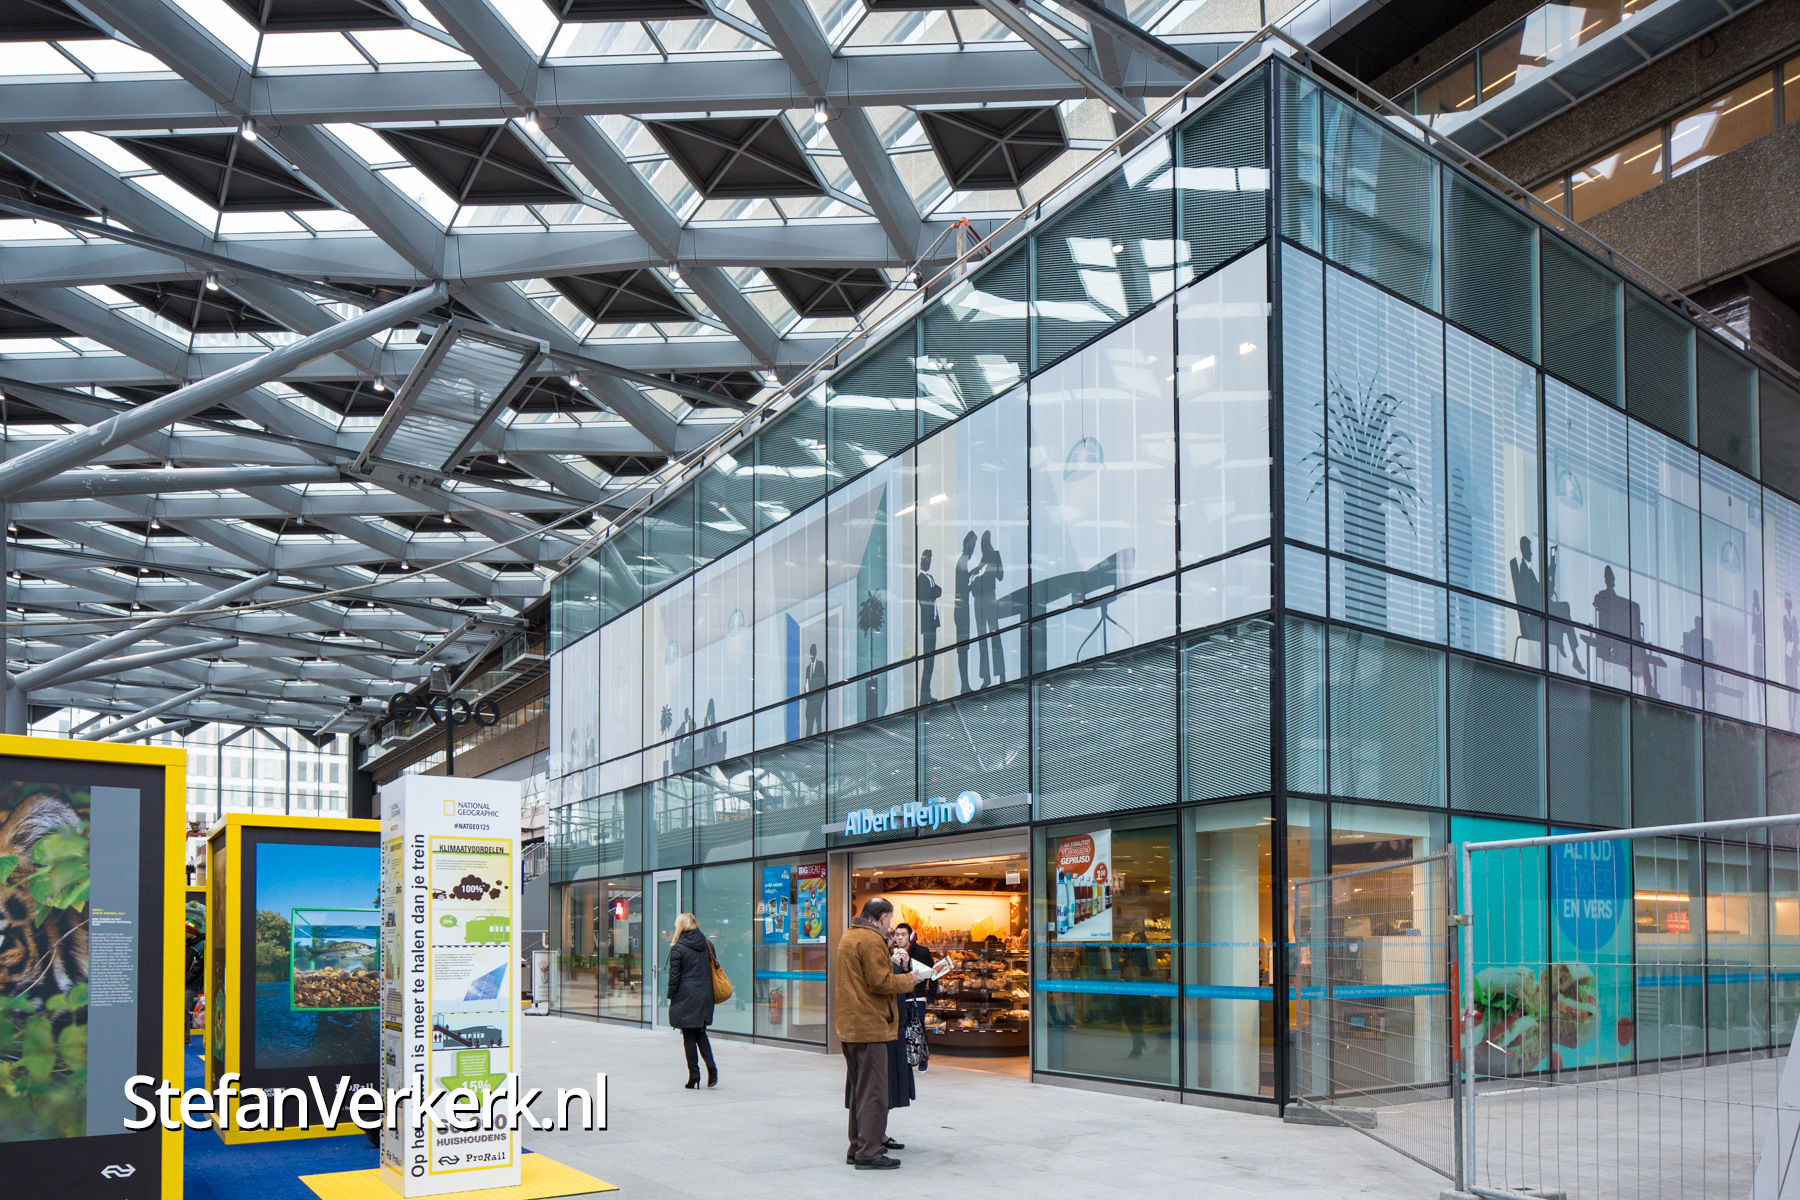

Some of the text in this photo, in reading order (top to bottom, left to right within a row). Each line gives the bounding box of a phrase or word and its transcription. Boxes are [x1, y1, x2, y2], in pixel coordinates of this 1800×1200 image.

[457, 802, 491, 810] NATIONAL
[457, 808, 500, 818] GEOGRAPHIC
[844, 796, 953, 837] Albert Heijn
[411, 834, 425, 870] trein
[439, 844, 505, 854] KLIMAATVOORDELEN
[1563, 840, 1612, 861] ALTIJD
[411, 875, 428, 890] je
[461, 885, 483, 893] 100%
[411, 895, 425, 924] dan
[1563, 898, 1613, 919] EN VERS
[411, 930, 425, 972] halen
[412, 978, 425, 993] te
[414, 998, 425, 1038] meer
[411, 1044, 425, 1057] is
[461, 1080, 490, 1094] 15%
[411, 1121, 425, 1149] he
[436, 1133, 507, 1146] HUISHOUDENS
[465, 1151, 506, 1162] ProRail
[411, 1154, 428, 1177] Op
